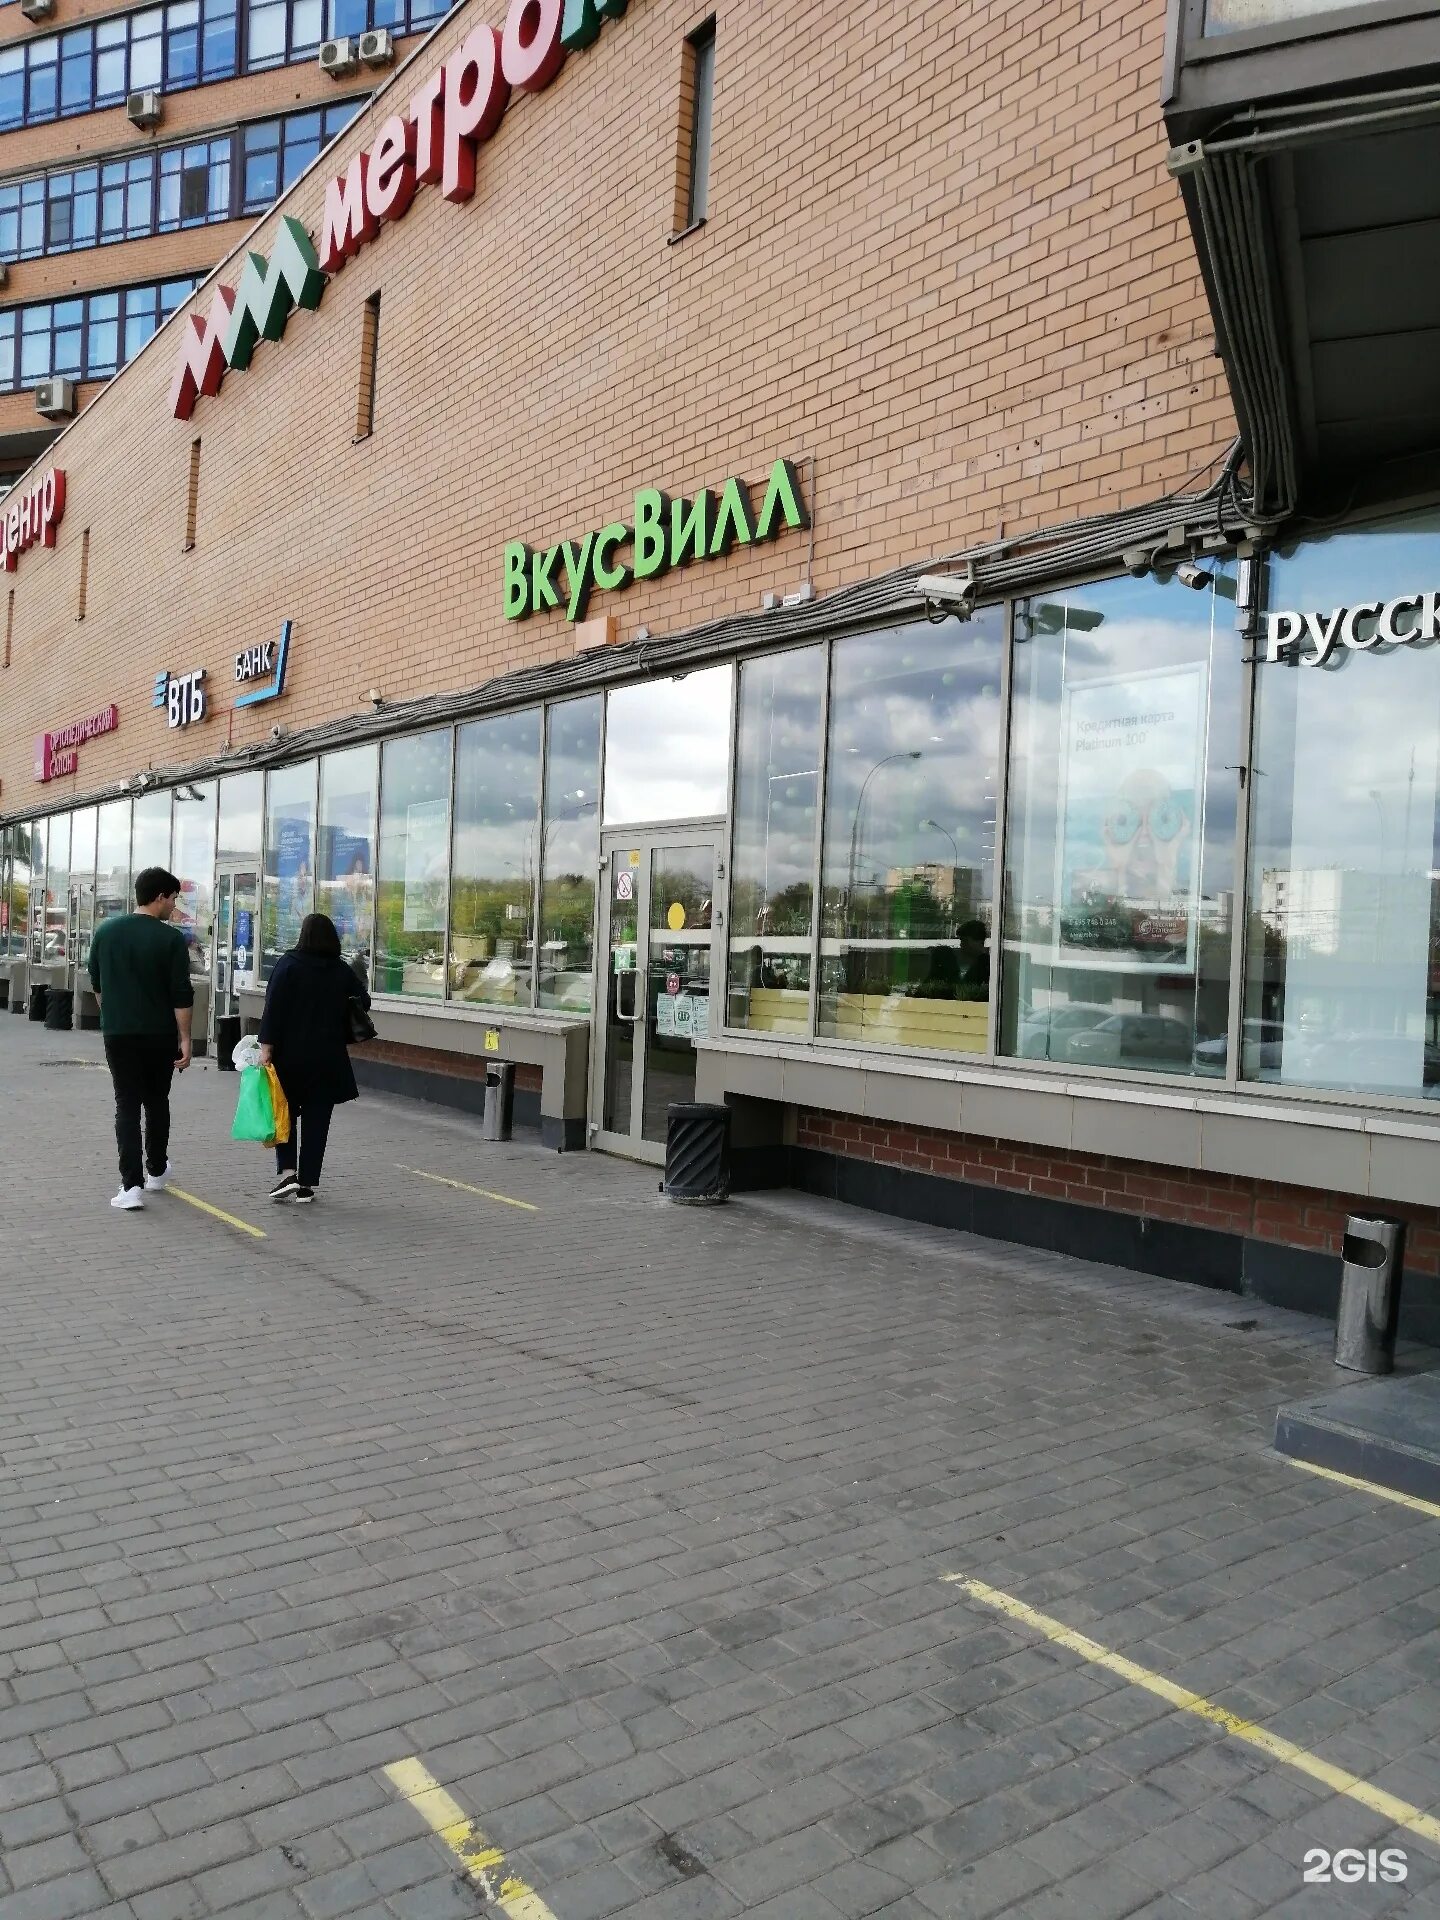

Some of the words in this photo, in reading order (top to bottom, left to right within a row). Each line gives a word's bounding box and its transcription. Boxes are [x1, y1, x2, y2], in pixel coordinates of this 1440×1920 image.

[318, 0, 612, 273] метро
[504, 458, 806, 622] ВкусВилл
[235, 642, 274, 681] БАНК
[168, 669, 206, 728] ВТБ
[1077, 715, 1137, 733] Кредитная
[1141, 711, 1175, 726] карта
[1075, 737, 1121, 752] Platinum
